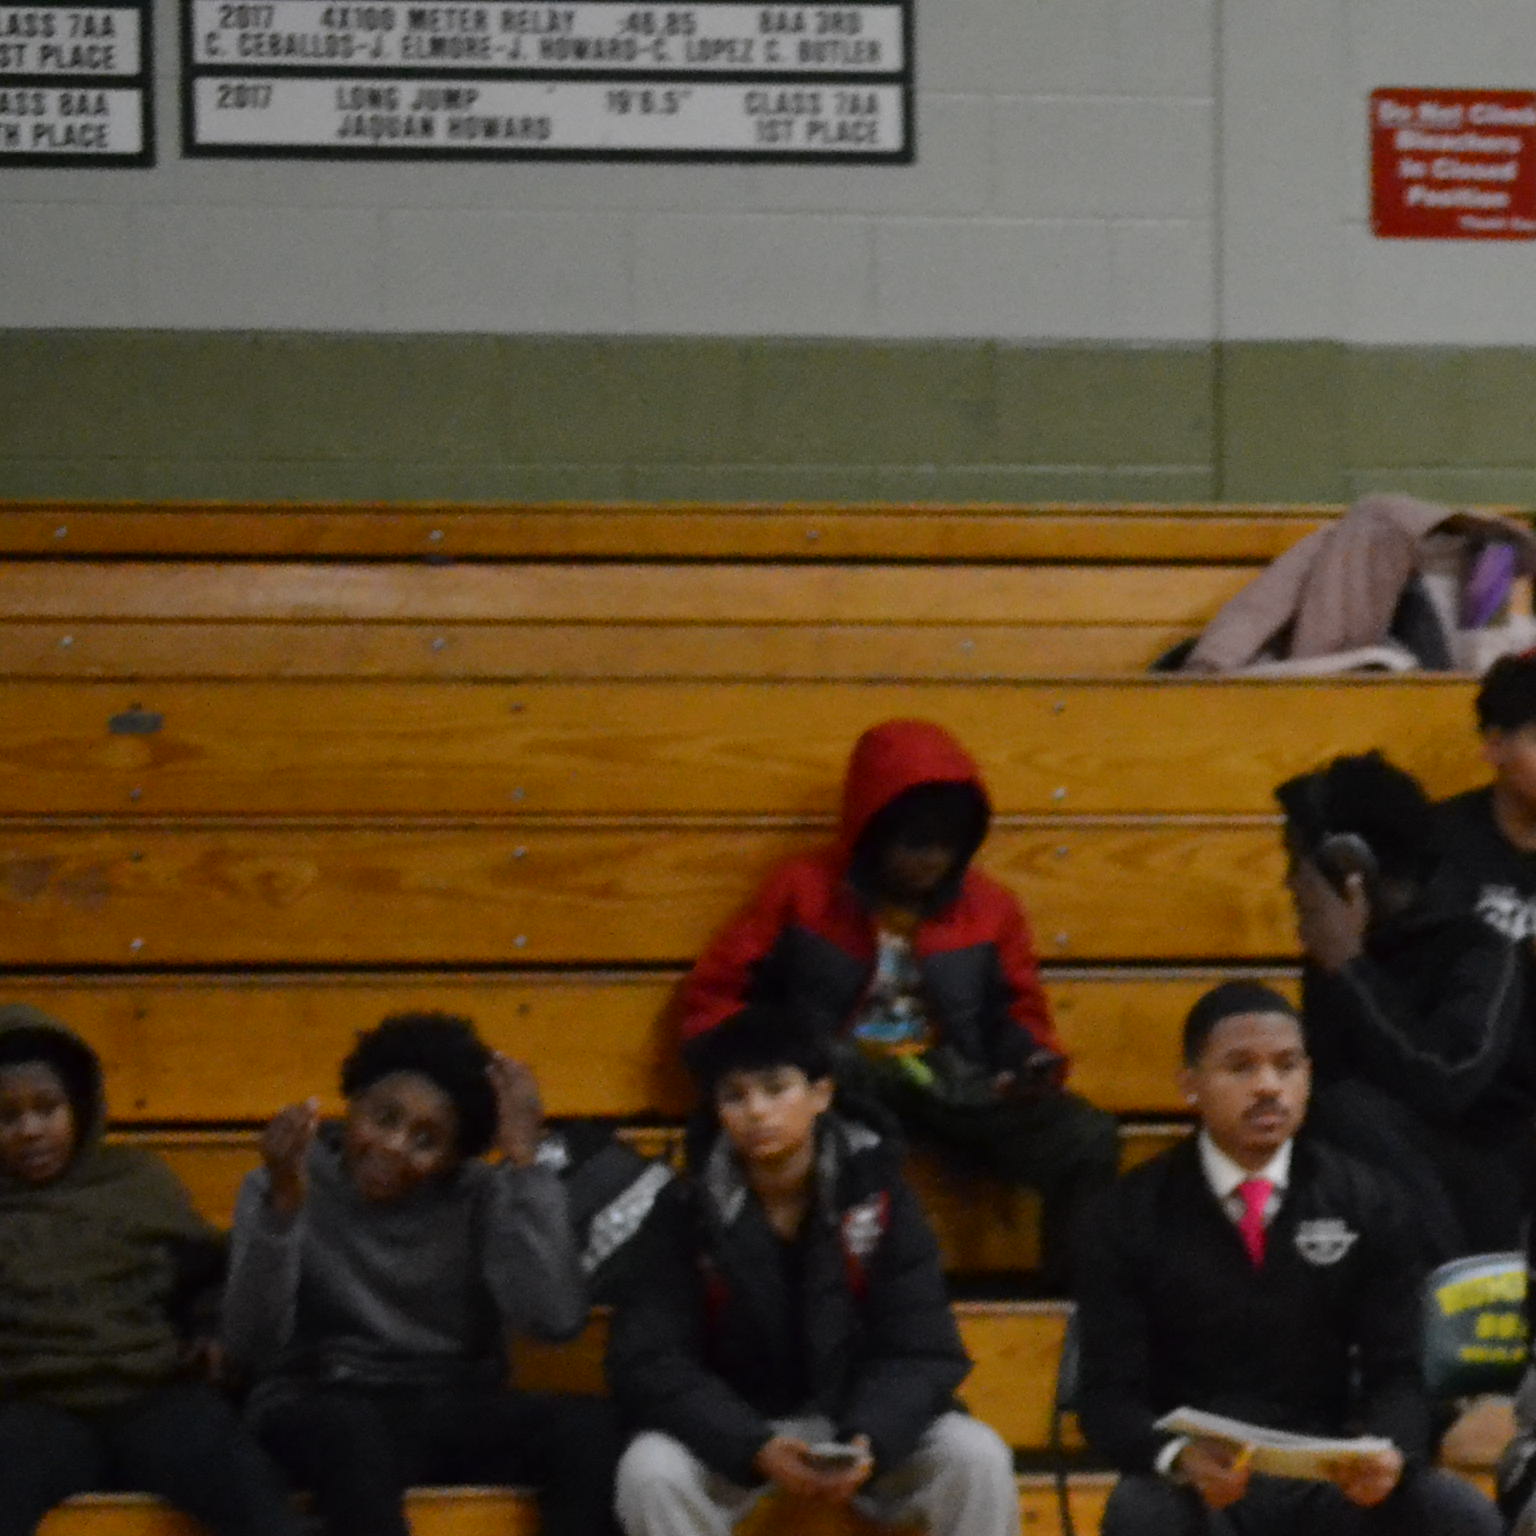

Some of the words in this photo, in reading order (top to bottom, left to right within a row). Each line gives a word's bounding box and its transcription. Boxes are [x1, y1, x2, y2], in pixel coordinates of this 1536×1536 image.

[0, 13, 55, 38] ASS
[67, 13, 116, 38] 7AA
[408, 8, 488, 33] METER
[502, 9, 575, 34] RELAY
[40, 44, 115, 69] PLACE
[745, 91, 822, 116] CLASS
[835, 92, 879, 116] 7AA
[31, 123, 109, 148] PLACE
[806, 119, 879, 144] PLACE
